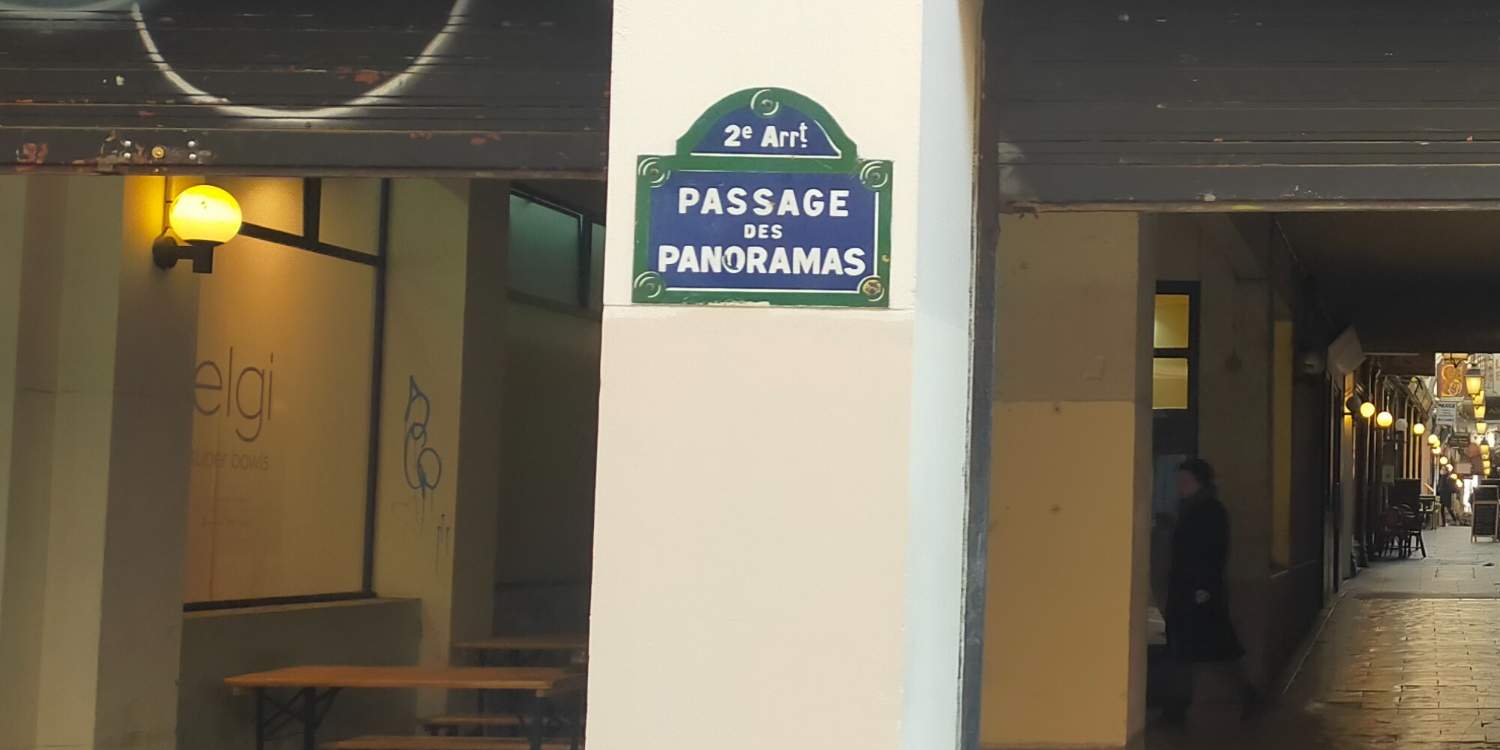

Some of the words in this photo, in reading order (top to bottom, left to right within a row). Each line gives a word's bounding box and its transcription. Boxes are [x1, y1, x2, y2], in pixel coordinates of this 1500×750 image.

[677, 186, 851, 218] PASSAGE
[743, 223, 784, 240] DES
[657, 244, 867, 277] PANORAMAS
